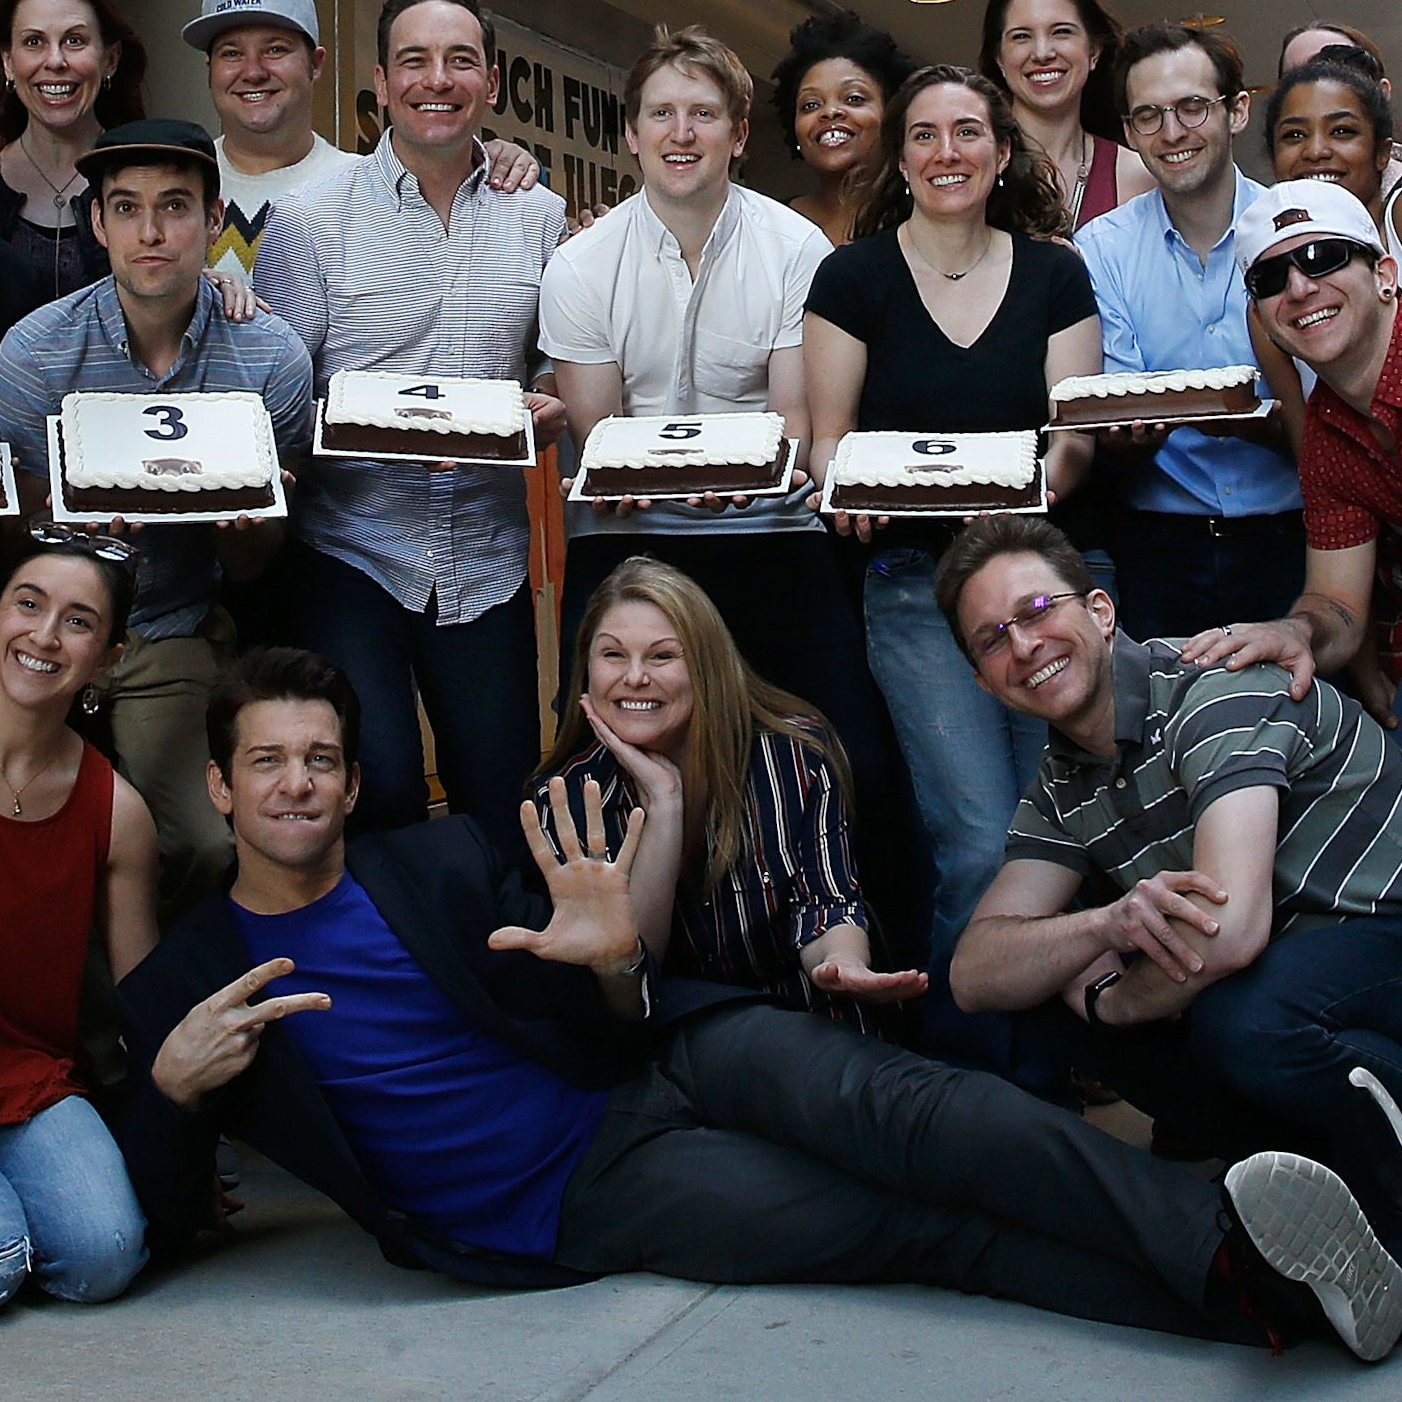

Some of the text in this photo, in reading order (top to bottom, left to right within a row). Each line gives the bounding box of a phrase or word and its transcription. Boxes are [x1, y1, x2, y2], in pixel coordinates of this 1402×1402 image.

[216, 0, 232, 12] COLD
[489, 48, 553, 133] UCH
[397, 382, 445, 401] 4
[142, 404, 189, 442] 3
[661, 422, 704, 441] 5
[911, 438, 959, 457] 6
